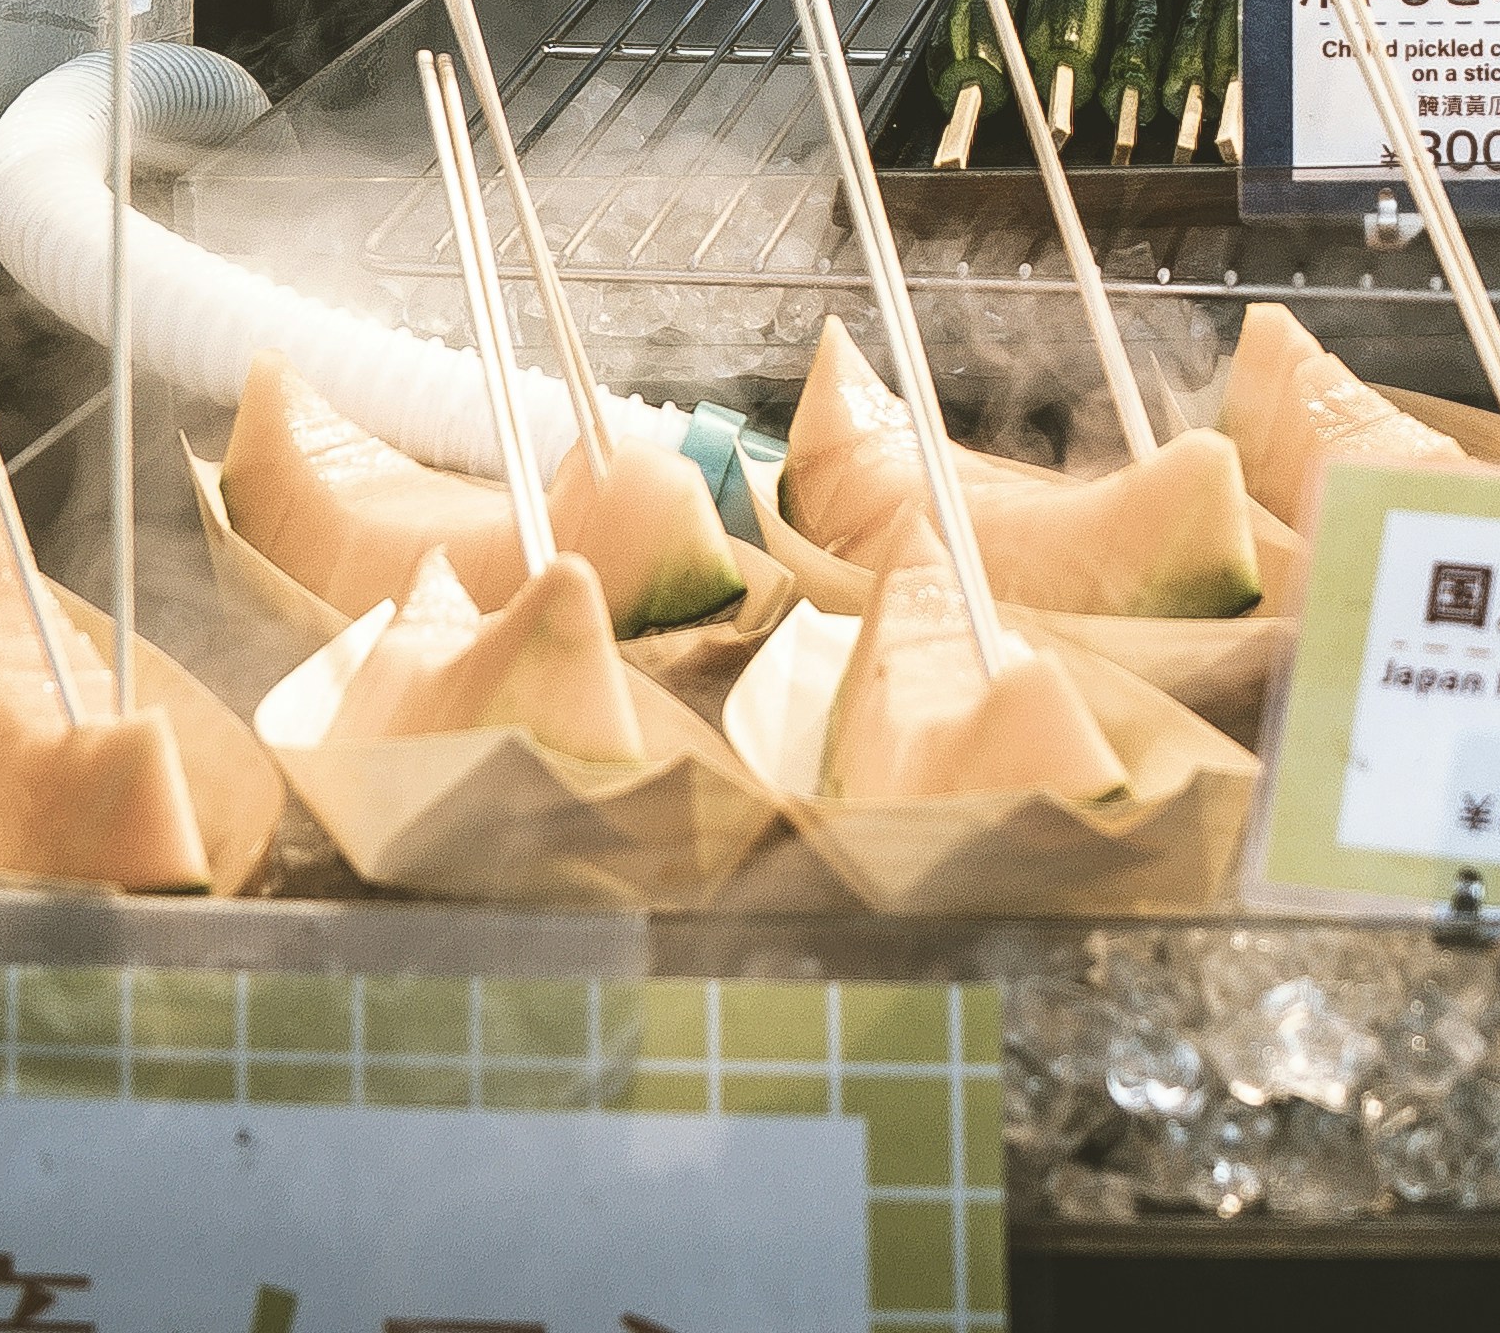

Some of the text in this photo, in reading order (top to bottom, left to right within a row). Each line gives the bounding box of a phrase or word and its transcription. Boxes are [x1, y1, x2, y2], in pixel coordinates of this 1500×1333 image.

[1405, 39, 1483, 61] pickled
[1412, 66, 1438, 81] on
[1445, 66, 1457, 81] a
[1382, 658, 1483, 695] Japan
